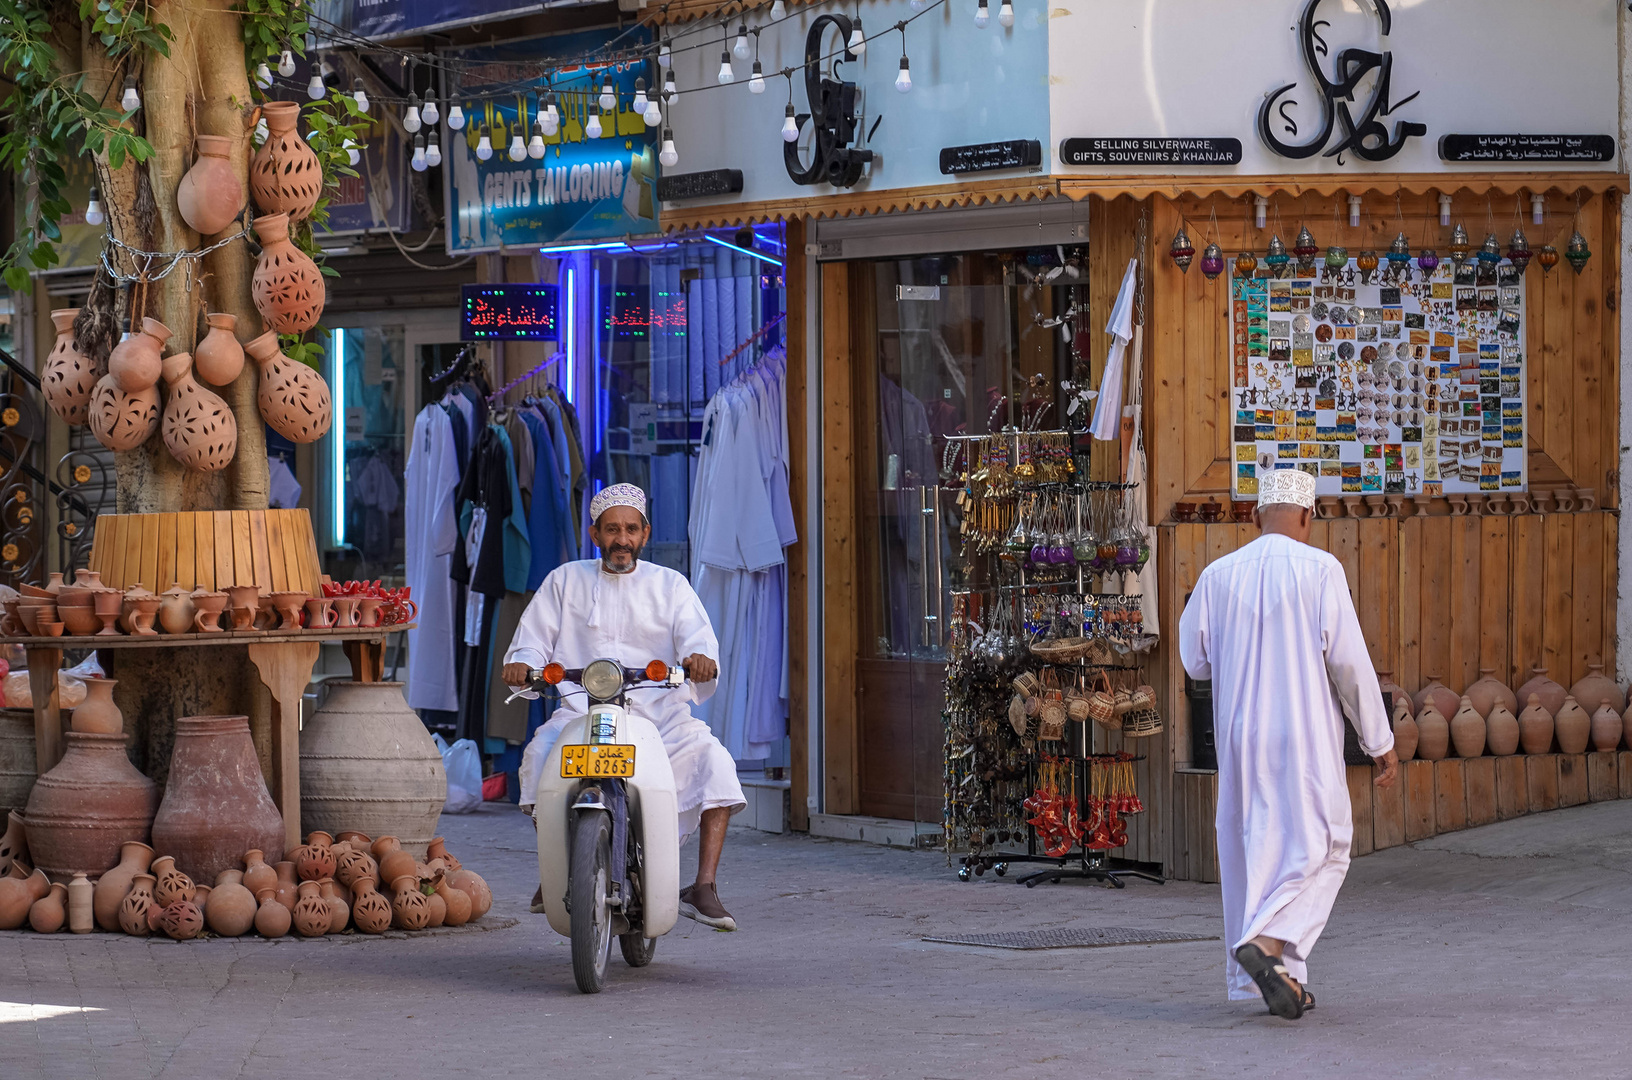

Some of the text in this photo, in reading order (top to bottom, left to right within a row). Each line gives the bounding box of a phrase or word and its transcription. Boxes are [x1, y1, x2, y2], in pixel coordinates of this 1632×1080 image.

[1093, 140, 1213, 150] SELLING SILVERWARE,
[1478, 136, 1582, 147] بيع الفضيات والهدايا
[1073, 152, 1233, 162] GIFTS, SOUVENIRS & KHANJAR
[1457, 149, 1603, 160] والتحف التذكارية والخناجر
[484, 169, 532, 209] GENTS
[535, 160, 624, 206] TAILORING
[594, 759, 627, 774] 8263
